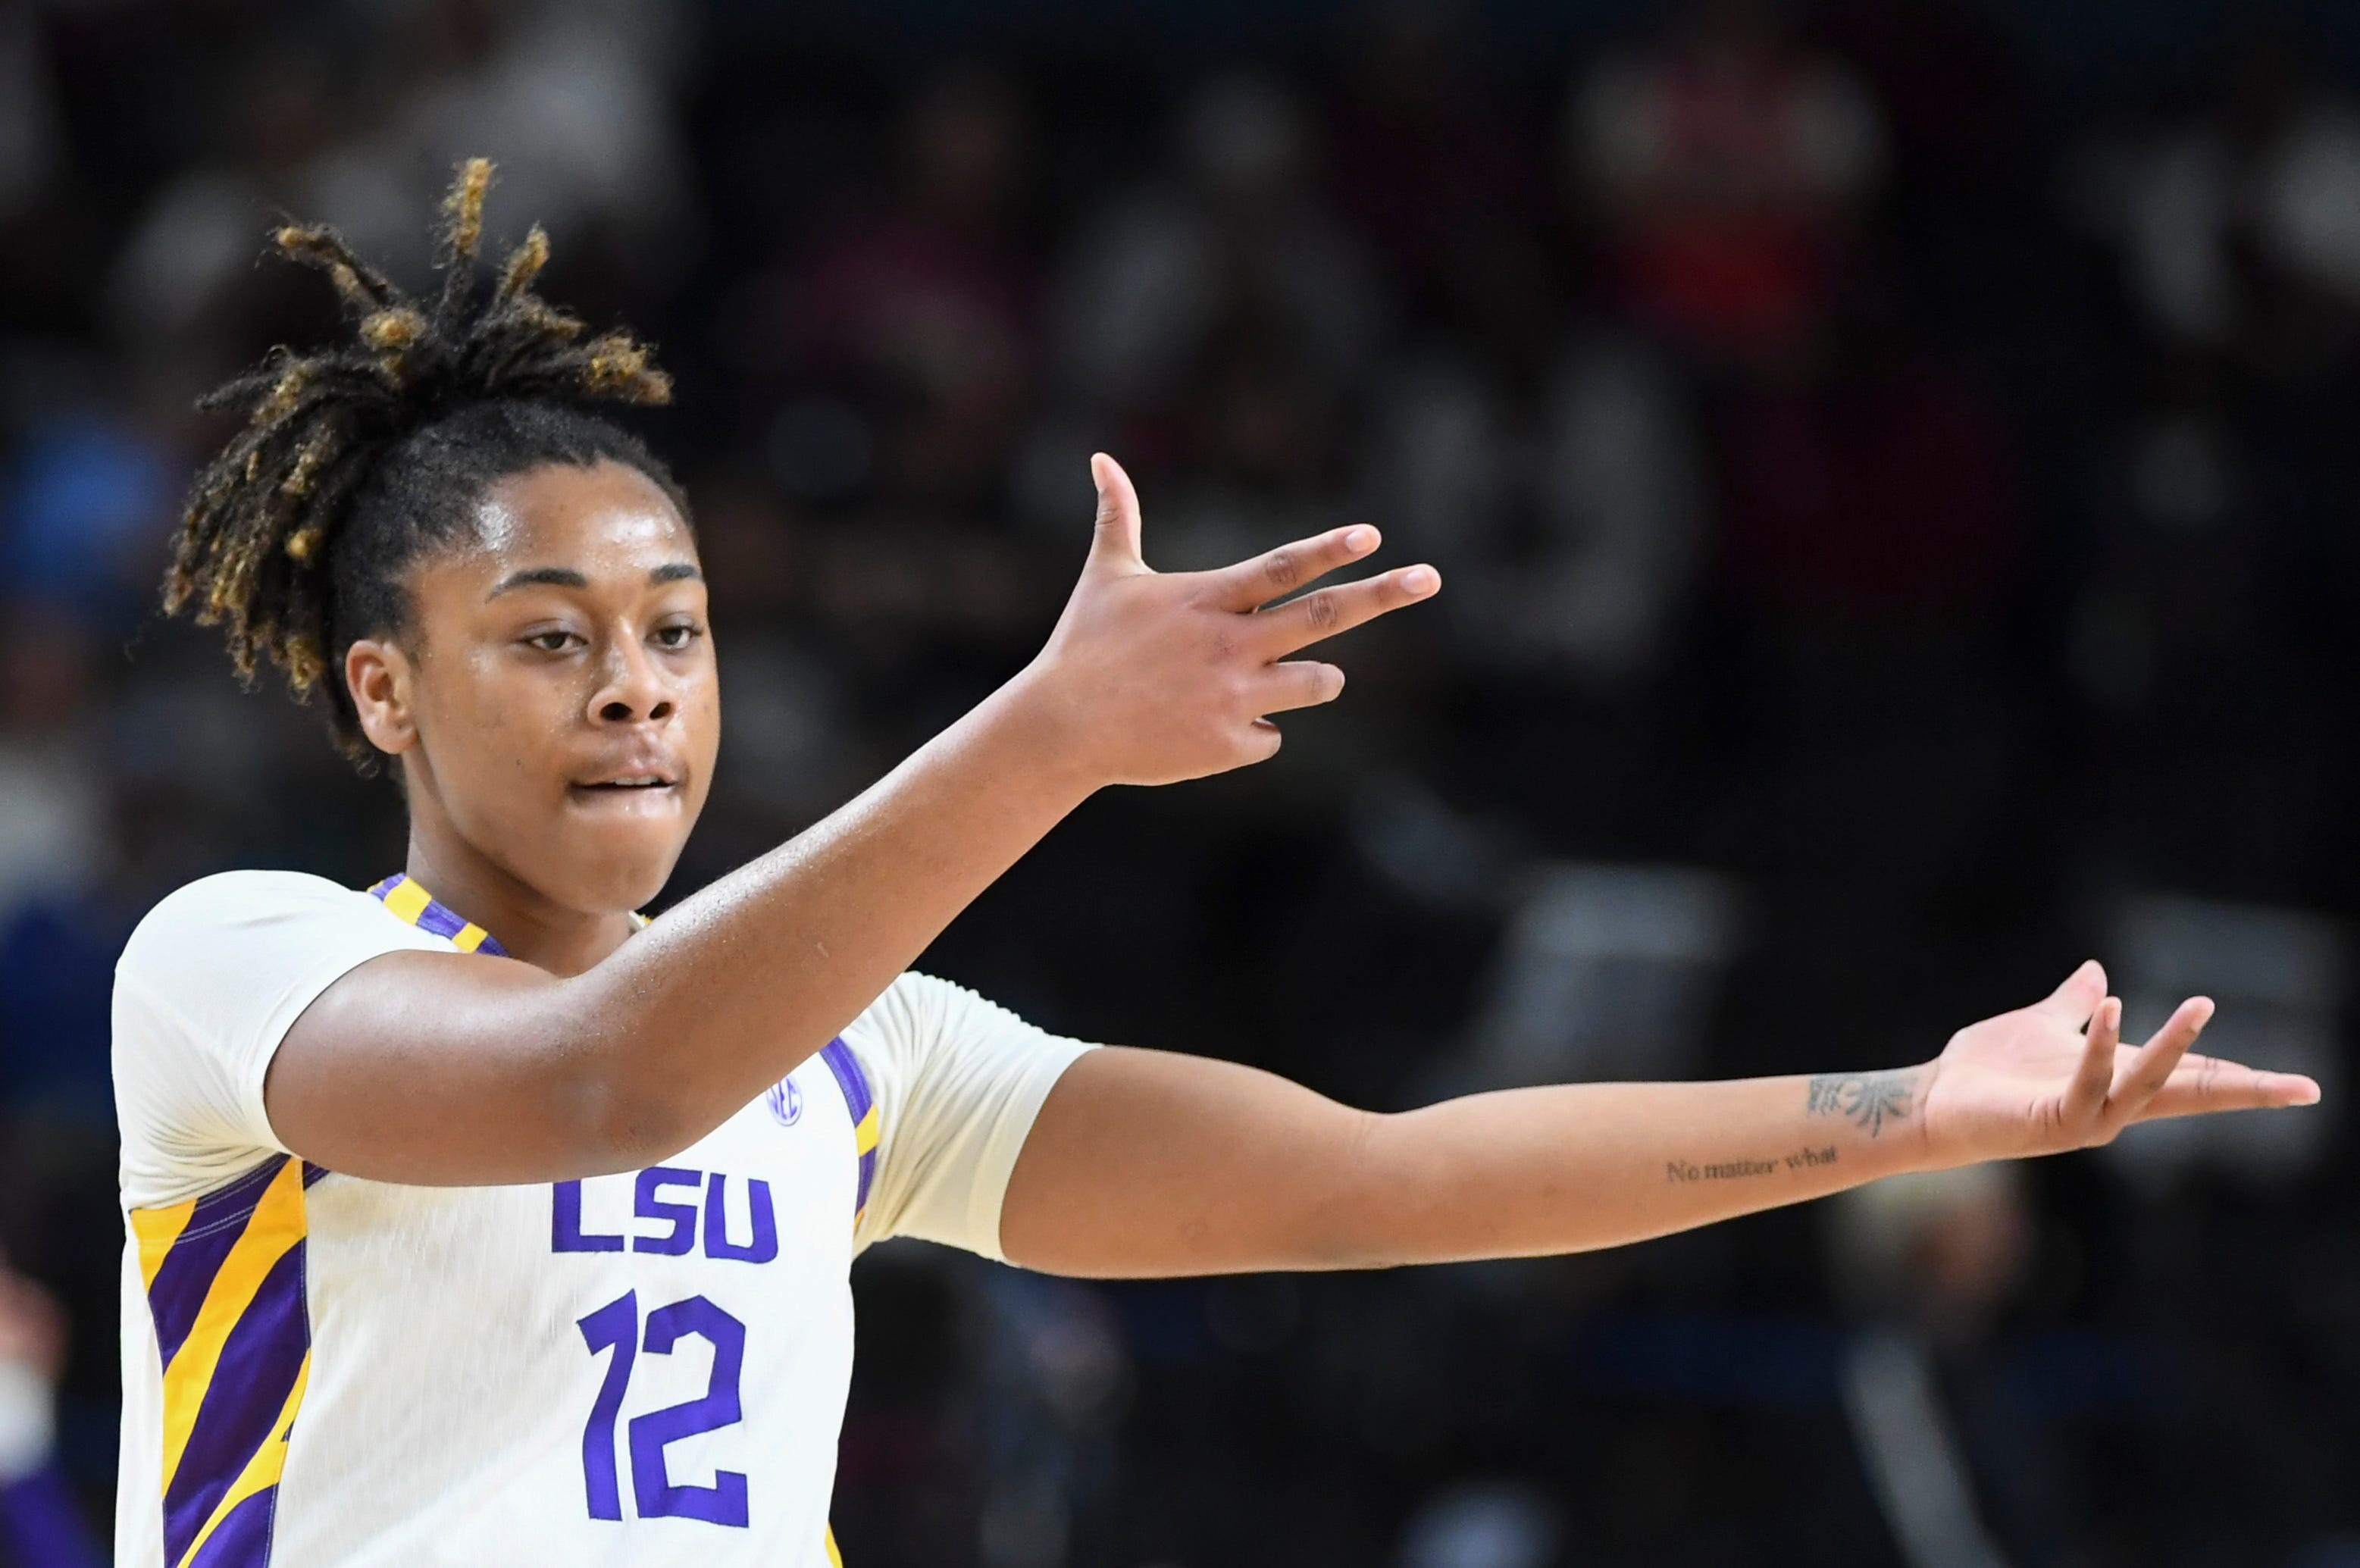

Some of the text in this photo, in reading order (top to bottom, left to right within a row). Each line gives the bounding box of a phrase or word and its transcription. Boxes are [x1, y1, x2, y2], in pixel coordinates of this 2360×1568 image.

[1667, 1146, 1837, 1182] No matter what
[552, 1166, 778, 1264] LSU
[577, 1288, 749, 1528] 12
